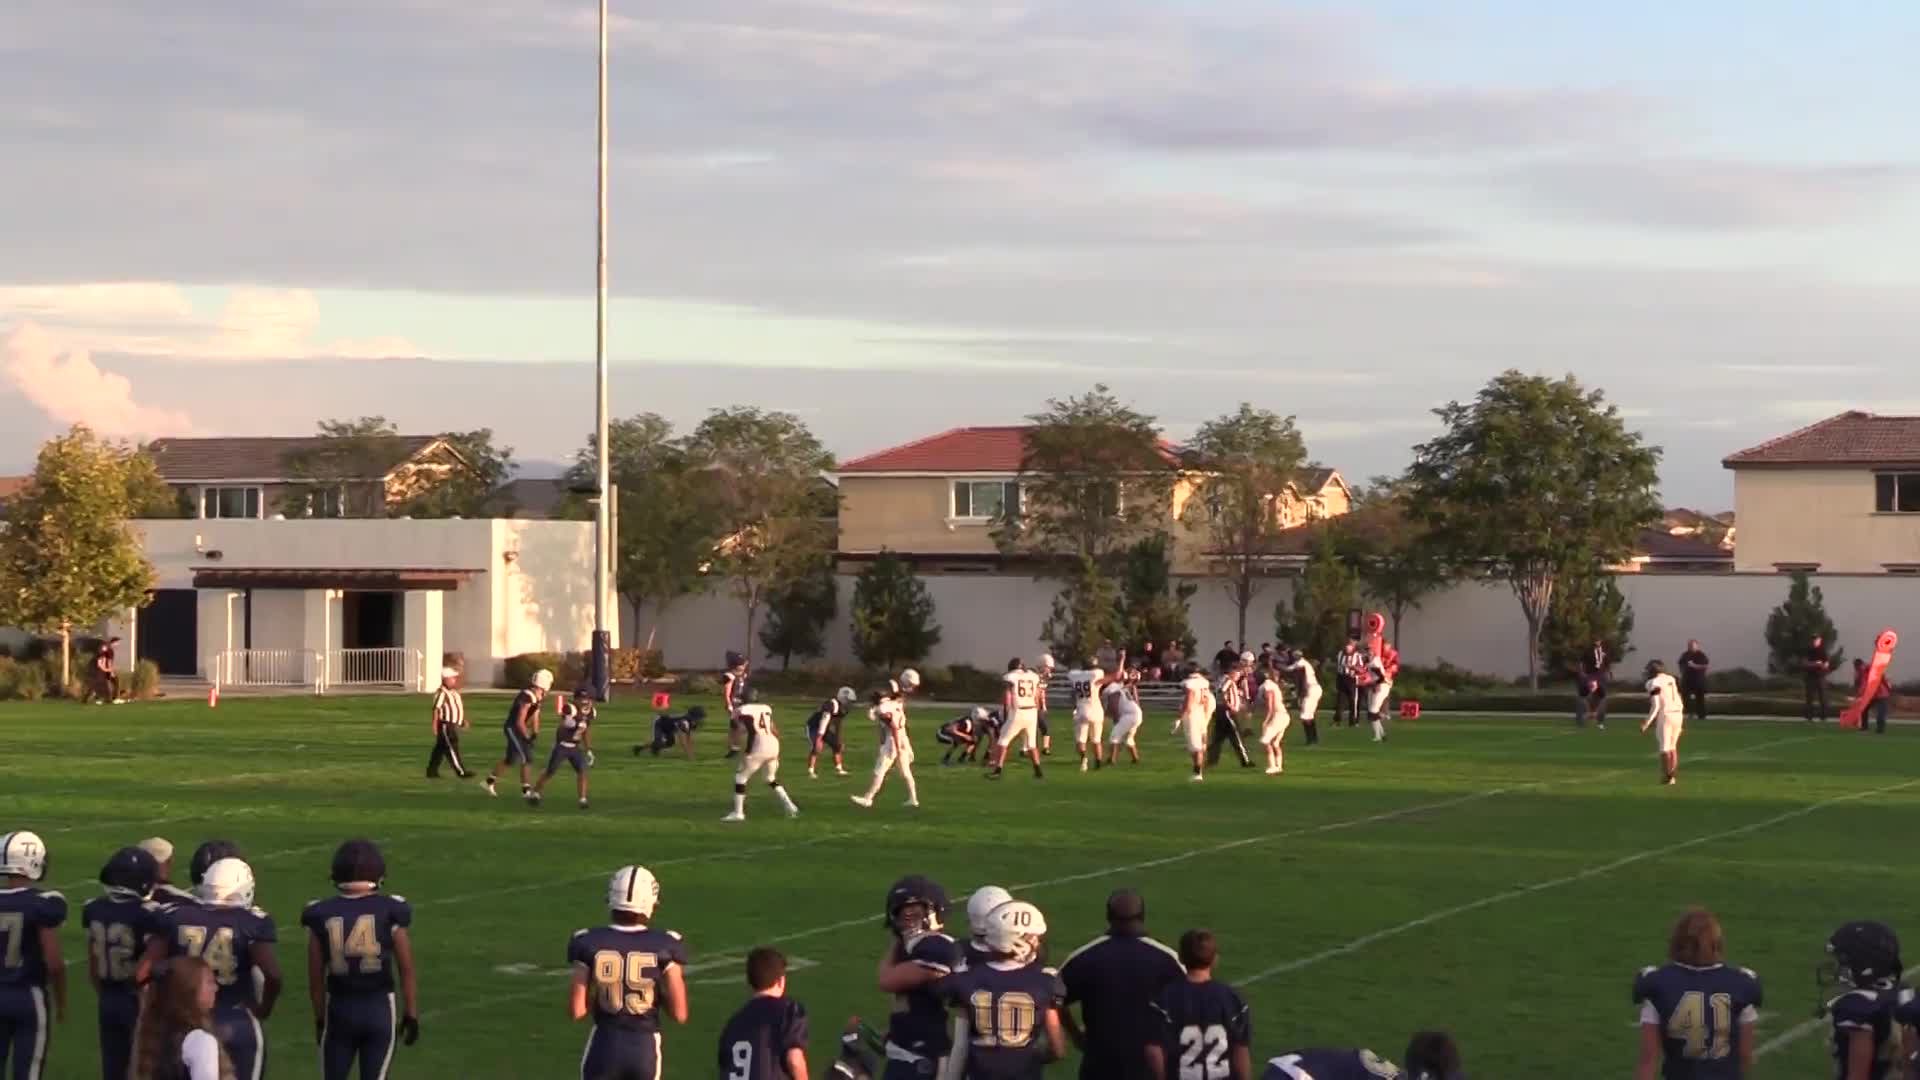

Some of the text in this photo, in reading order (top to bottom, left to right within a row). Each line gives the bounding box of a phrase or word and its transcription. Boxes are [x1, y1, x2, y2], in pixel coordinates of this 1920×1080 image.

[1017, 679, 1034, 697] 63
[325, 914, 382, 974] 14
[1013, 911, 1032, 927] 10
[178, 924, 238, 985] 74
[594, 950, 658, 1015] 85
[970, 990, 1035, 1047] 10
[1668, 991, 1732, 1060] 41
[729, 1040, 752, 1080] 9
[1179, 1024, 1230, 1080] 22
